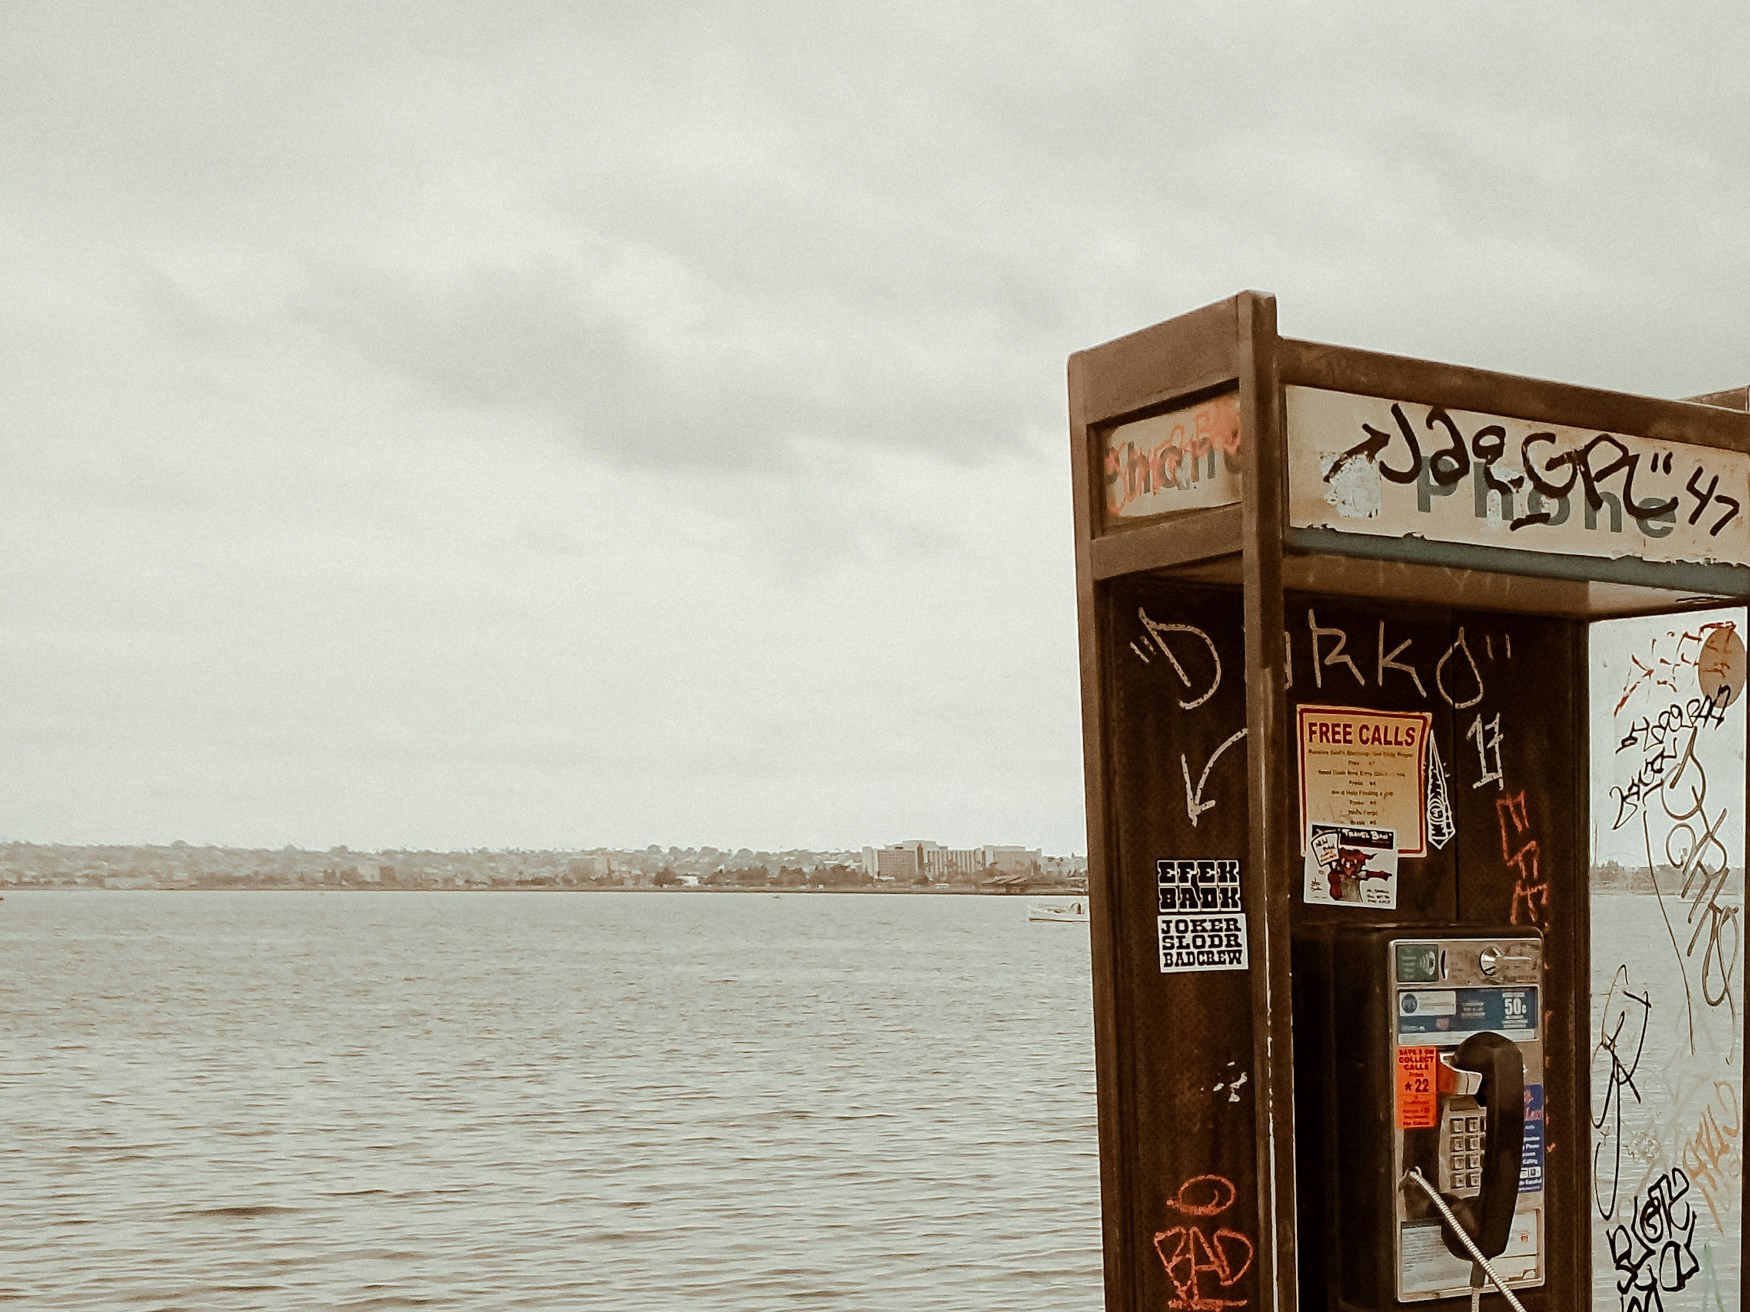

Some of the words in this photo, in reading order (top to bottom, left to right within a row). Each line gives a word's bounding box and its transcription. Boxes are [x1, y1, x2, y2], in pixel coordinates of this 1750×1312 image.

[1308, 721, 1353, 745] FREE
[1358, 724, 1416, 747] CALLS
[1161, 918, 1241, 934] JOKER
[1162, 933, 1242, 950] SLODR
[1163, 949, 1243, 968] BADCREW
